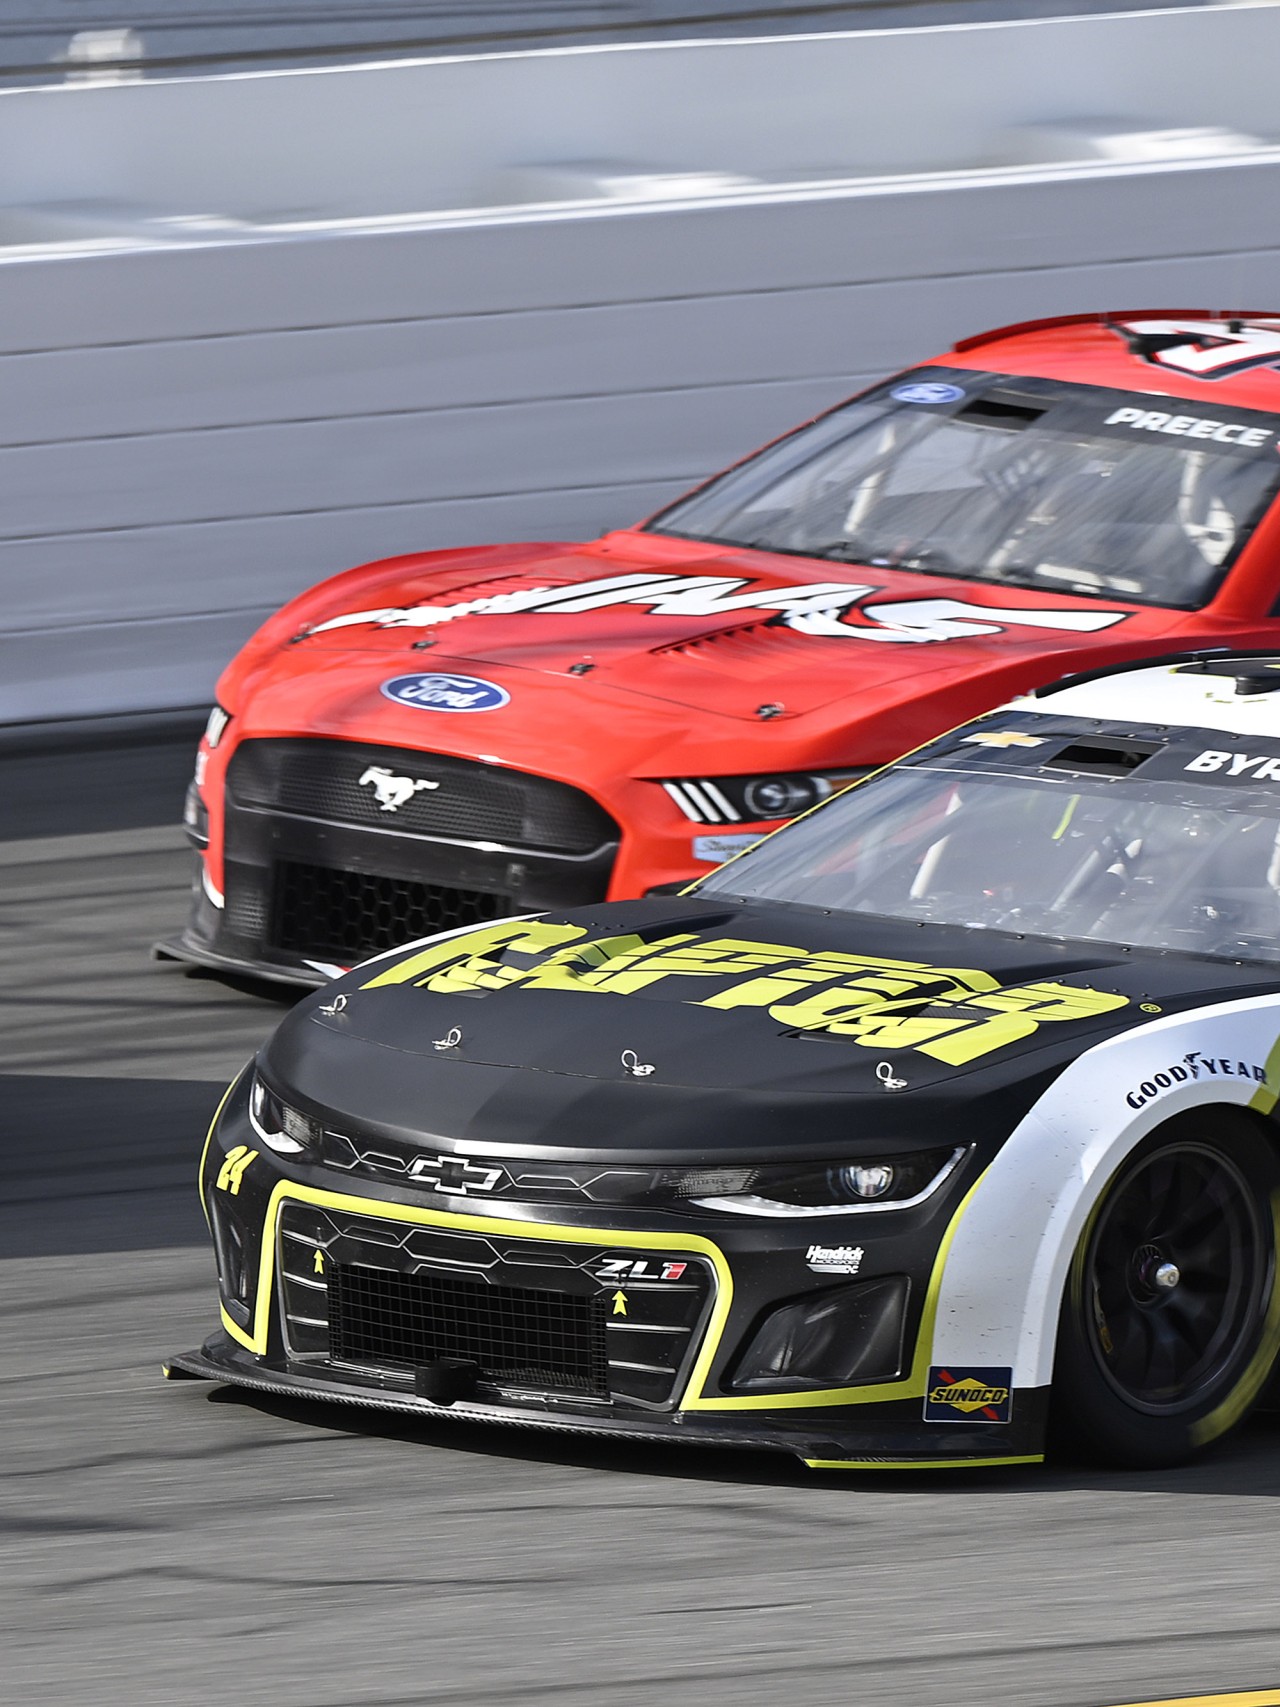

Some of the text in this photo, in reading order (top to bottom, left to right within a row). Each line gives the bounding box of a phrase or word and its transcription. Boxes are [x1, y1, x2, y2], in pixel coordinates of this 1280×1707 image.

[1104, 407, 1274, 447] PREECE
[397, 676, 490, 708] Ford
[215, 1145, 260, 1196] 24
[805, 1245, 864, 1263] Hendrick
[595, 1258, 687, 1280] ZL1
[932, 1388, 1004, 1403] SUNOCO
